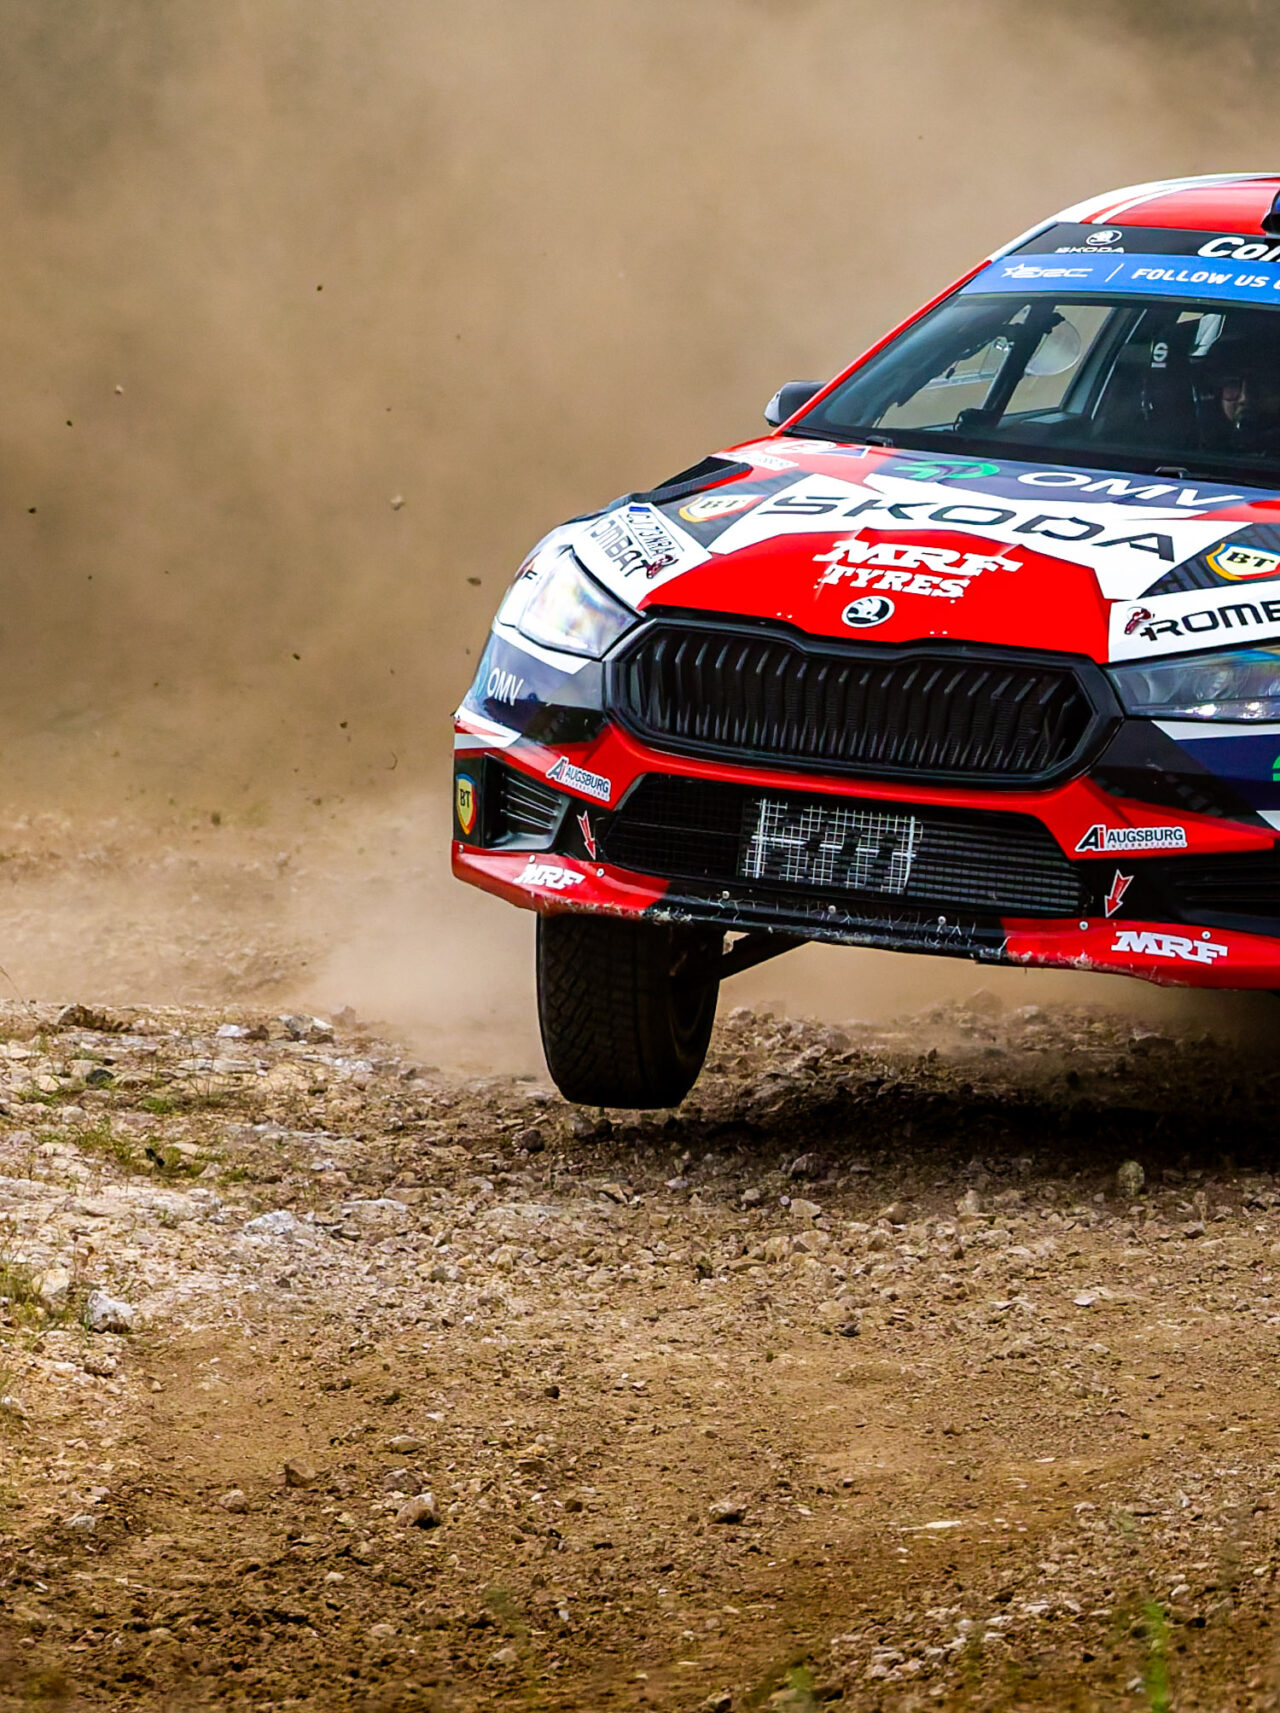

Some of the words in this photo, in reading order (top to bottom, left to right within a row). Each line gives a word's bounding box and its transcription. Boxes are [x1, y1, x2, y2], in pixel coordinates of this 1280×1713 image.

[1130, 267, 1234, 285] FOLLOW
[1234, 274, 1270, 289] US
[1016, 472, 1246, 508] OMV
[813, 539, 1024, 577] MRF
[1226, 551, 1275, 568] BT
[816, 565, 965, 599] TYRES
[487, 668, 523, 706] OMV
[566, 766, 610, 794] AUGSBURG
[459, 787, 471, 809] BT
[1107, 828, 1184, 844] AUGSBURG
[514, 863, 585, 890] MRF
[1111, 931, 1228, 965] MRF
